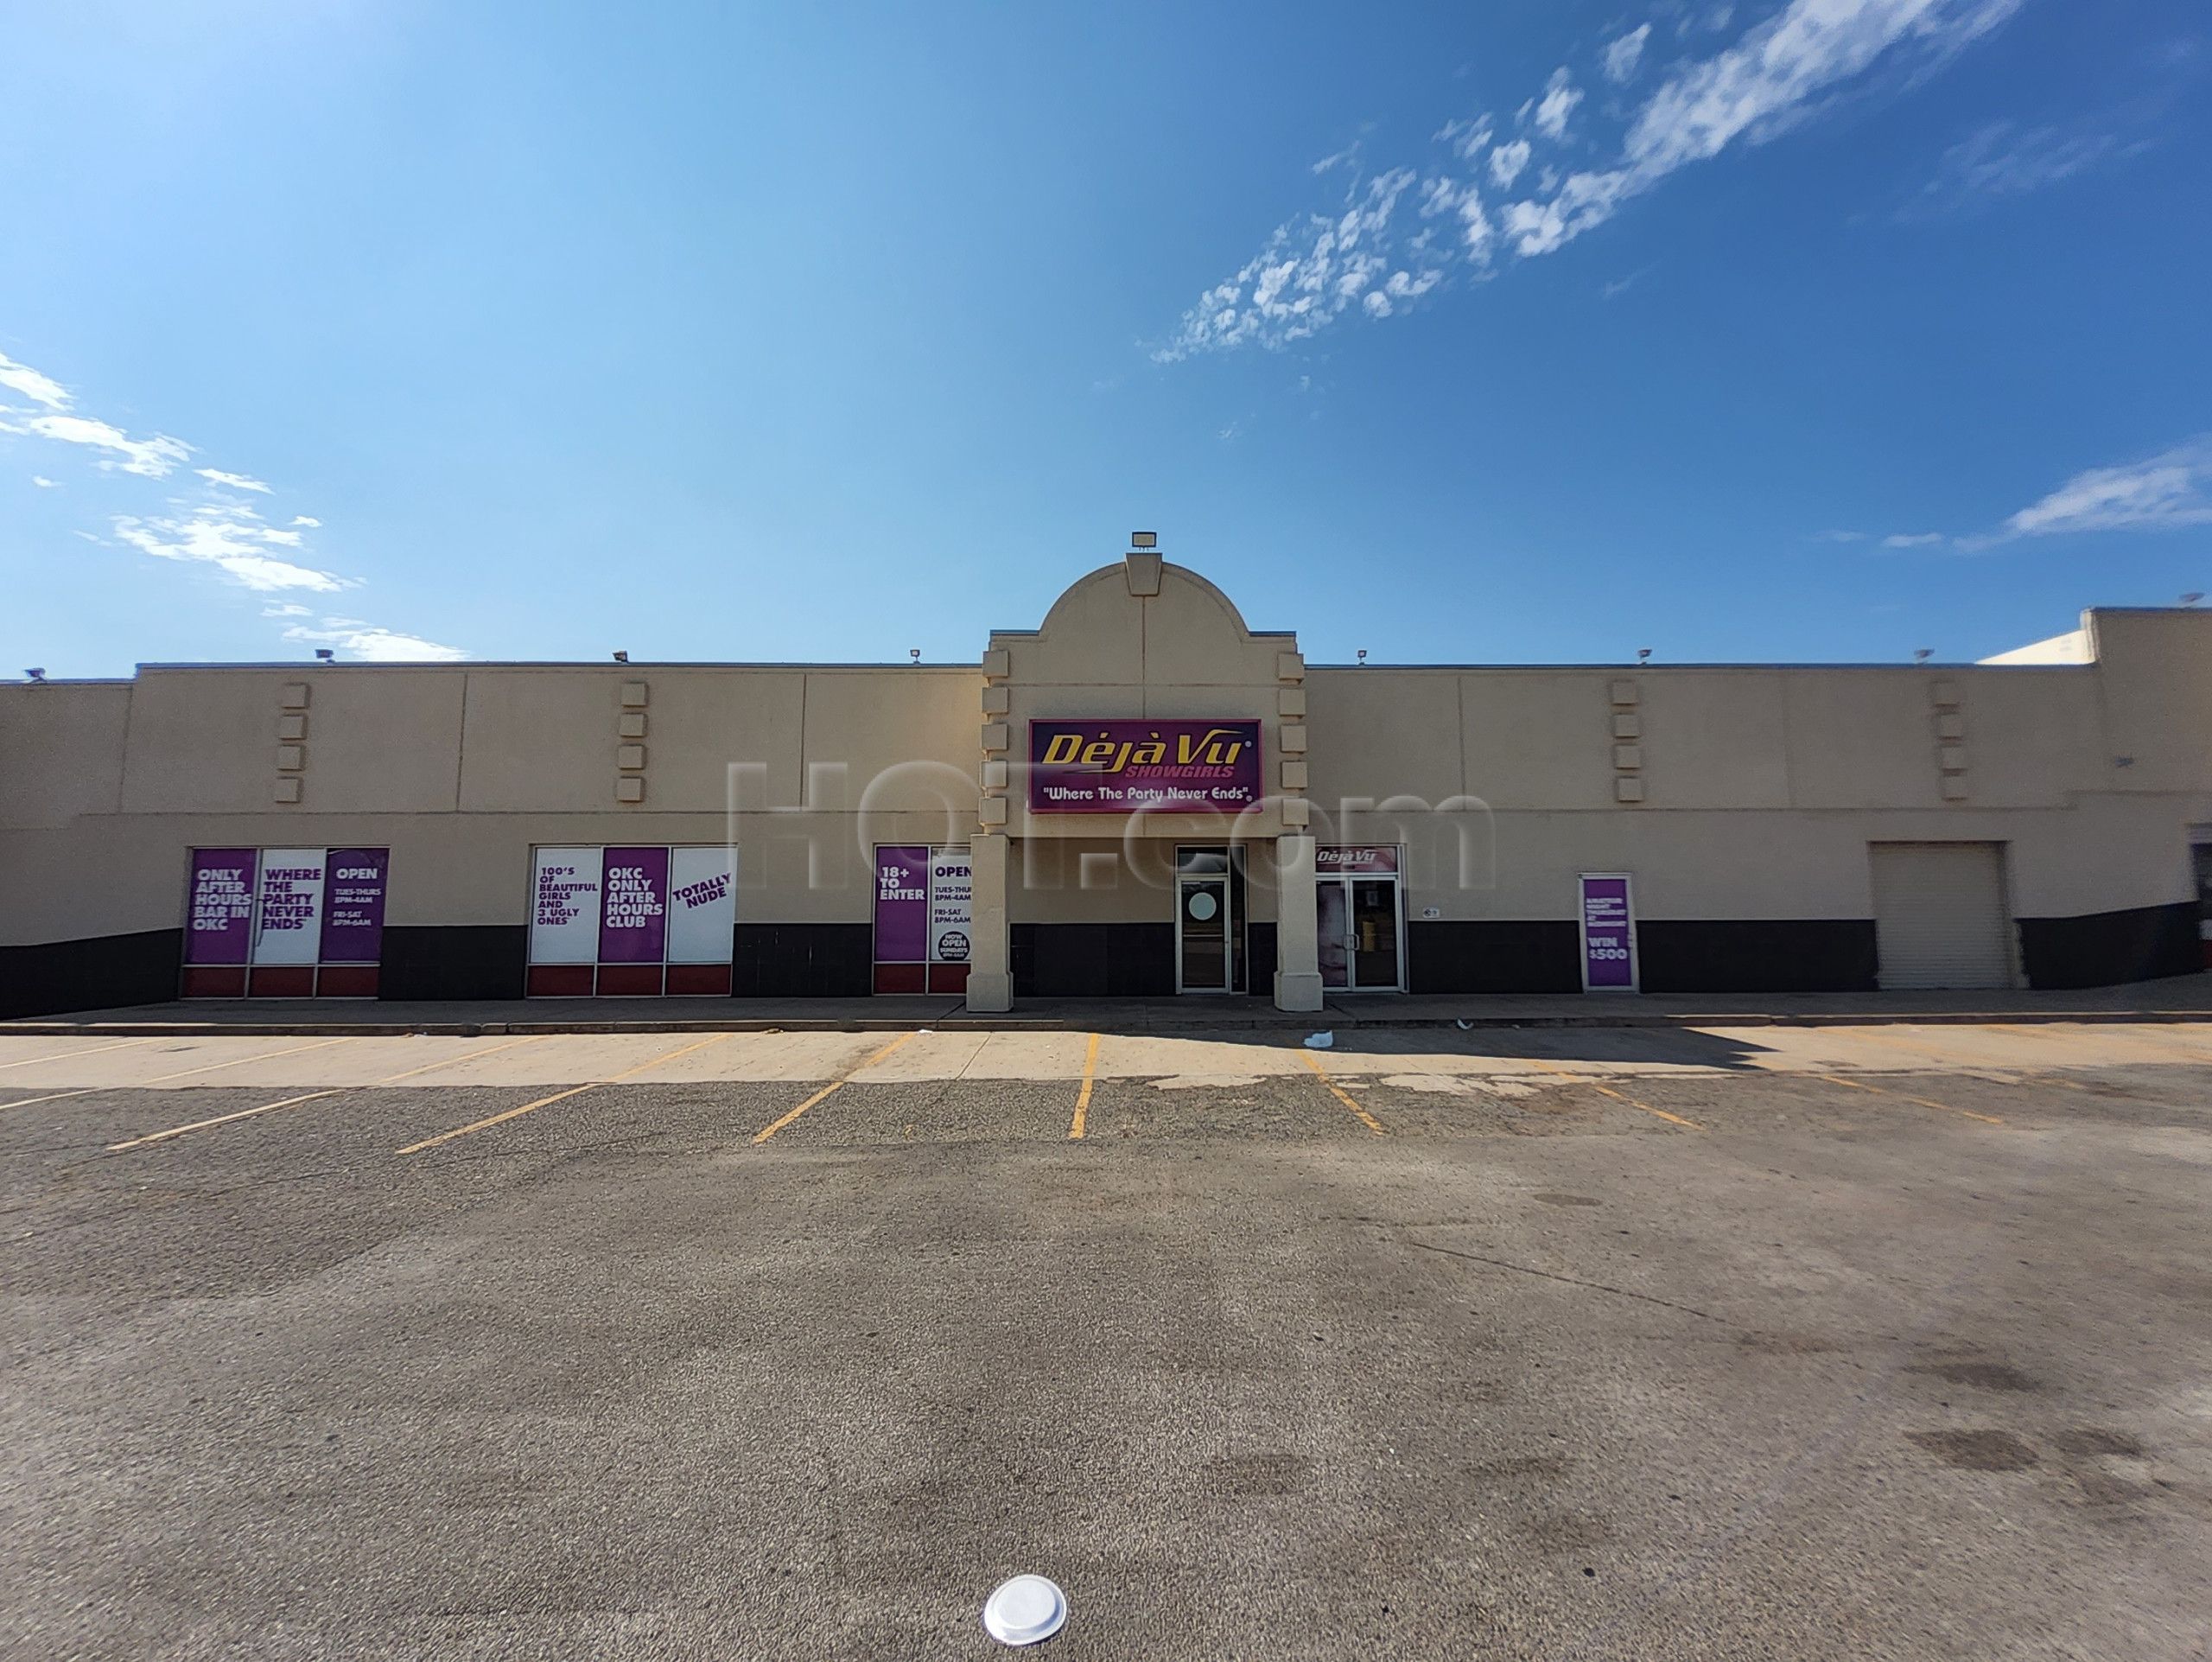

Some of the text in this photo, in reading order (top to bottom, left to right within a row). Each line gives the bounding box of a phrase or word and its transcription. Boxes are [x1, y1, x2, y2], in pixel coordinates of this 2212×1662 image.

[1042, 729, 1243, 774] Déjà Vu
[1125, 765, 1235, 778] SHOWGIRLS
[1043, 787, 1093, 800] "Where
[1098, 787, 1123, 799] The
[1127, 787, 1163, 803] Party
[1167, 787, 1206, 799] Never
[1355, 849, 1377, 861] Vu
[198, 869, 243, 881] ONLY
[264, 869, 321, 881] WHERE
[336, 868, 378, 879] OPEN
[541, 867, 575, 876] 100'S
[608, 867, 643, 879] OKC
[882, 867, 909, 877] 18+
[935, 866, 972, 877] OPEN
[196, 882, 245, 893] AFTER
[264, 882, 292, 893] THE
[539, 883, 598, 892] BEAUTIFUL
[607, 880, 652, 891] ONLY
[672, 872, 732, 901] TOTALLY
[880, 878, 899, 888] TO
[195, 894, 251, 906] HOURS
[263, 894, 314, 905] PARTY
[607, 892, 655, 903] AFTER
[685, 887, 727, 908] NUDE
[880, 889, 925, 900] ENTER
[194, 906, 250, 918] BAR IN
[262, 906, 314, 917] NEVER
[550, 908, 580, 917] UGLY
[607, 903, 663, 915] HOURS
[193, 919, 228, 931] OKC
[606, 916, 646, 927] CLUB
[1588, 937, 1618, 947] WIN
[1589, 948, 1627, 960] $500
